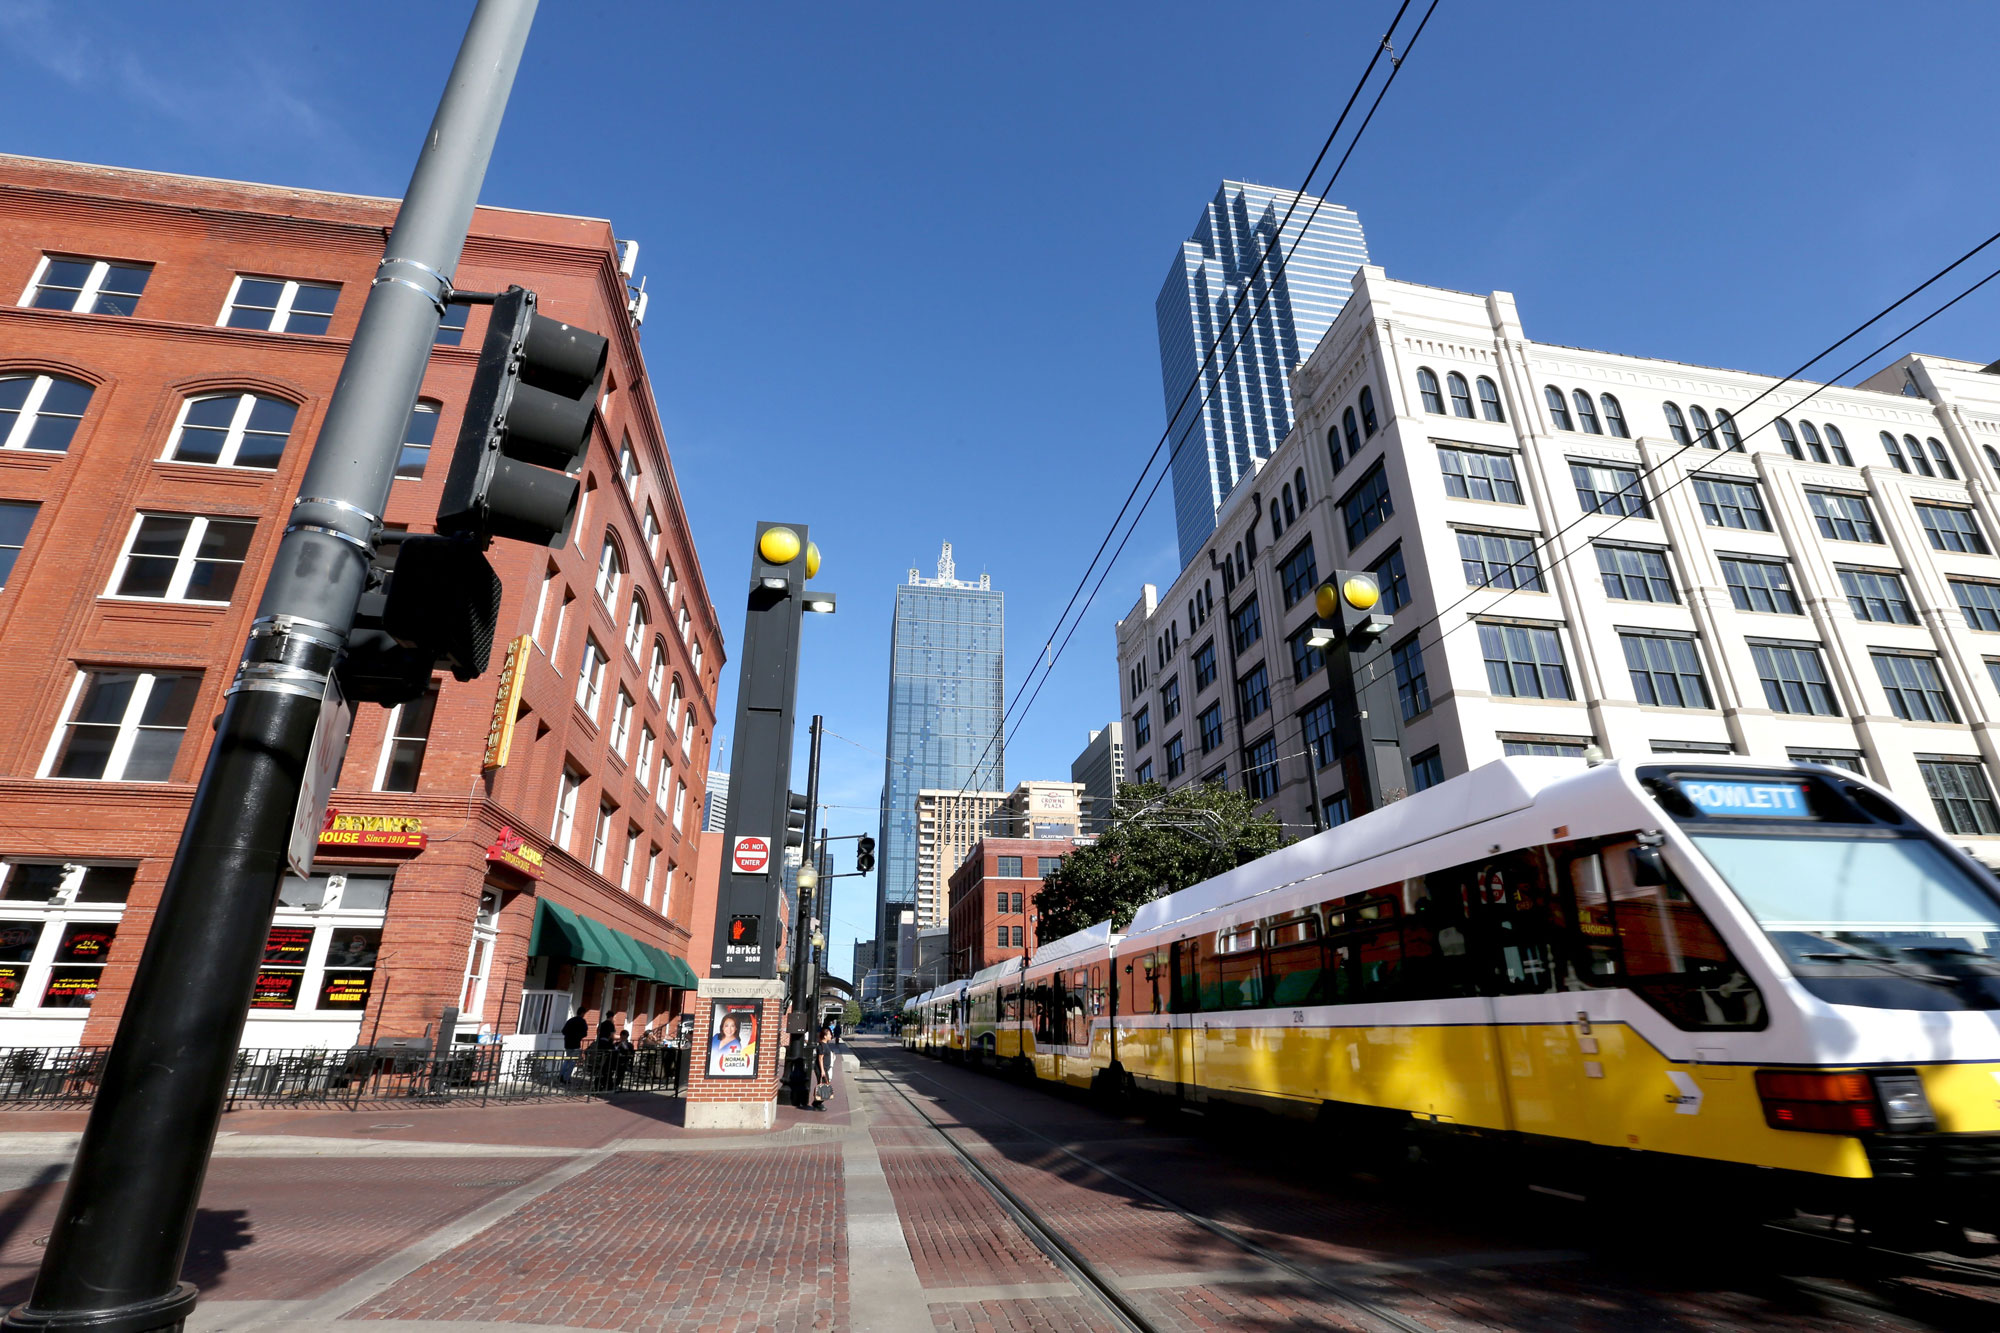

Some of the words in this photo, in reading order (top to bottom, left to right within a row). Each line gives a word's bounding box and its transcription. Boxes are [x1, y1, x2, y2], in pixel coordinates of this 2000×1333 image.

[484, 639, 519, 764] BARBECUE
[1685, 784, 1797, 808] ROWLETT
[333, 815, 422, 832] BRYAN'S
[319, 832, 360, 843] HOUSE
[364, 834, 386, 843] Since
[387, 835, 406, 844] 1910
[726, 945, 761, 954] Market
[257, 975, 293, 988] Catering
[745, 987, 771, 995] STATION
